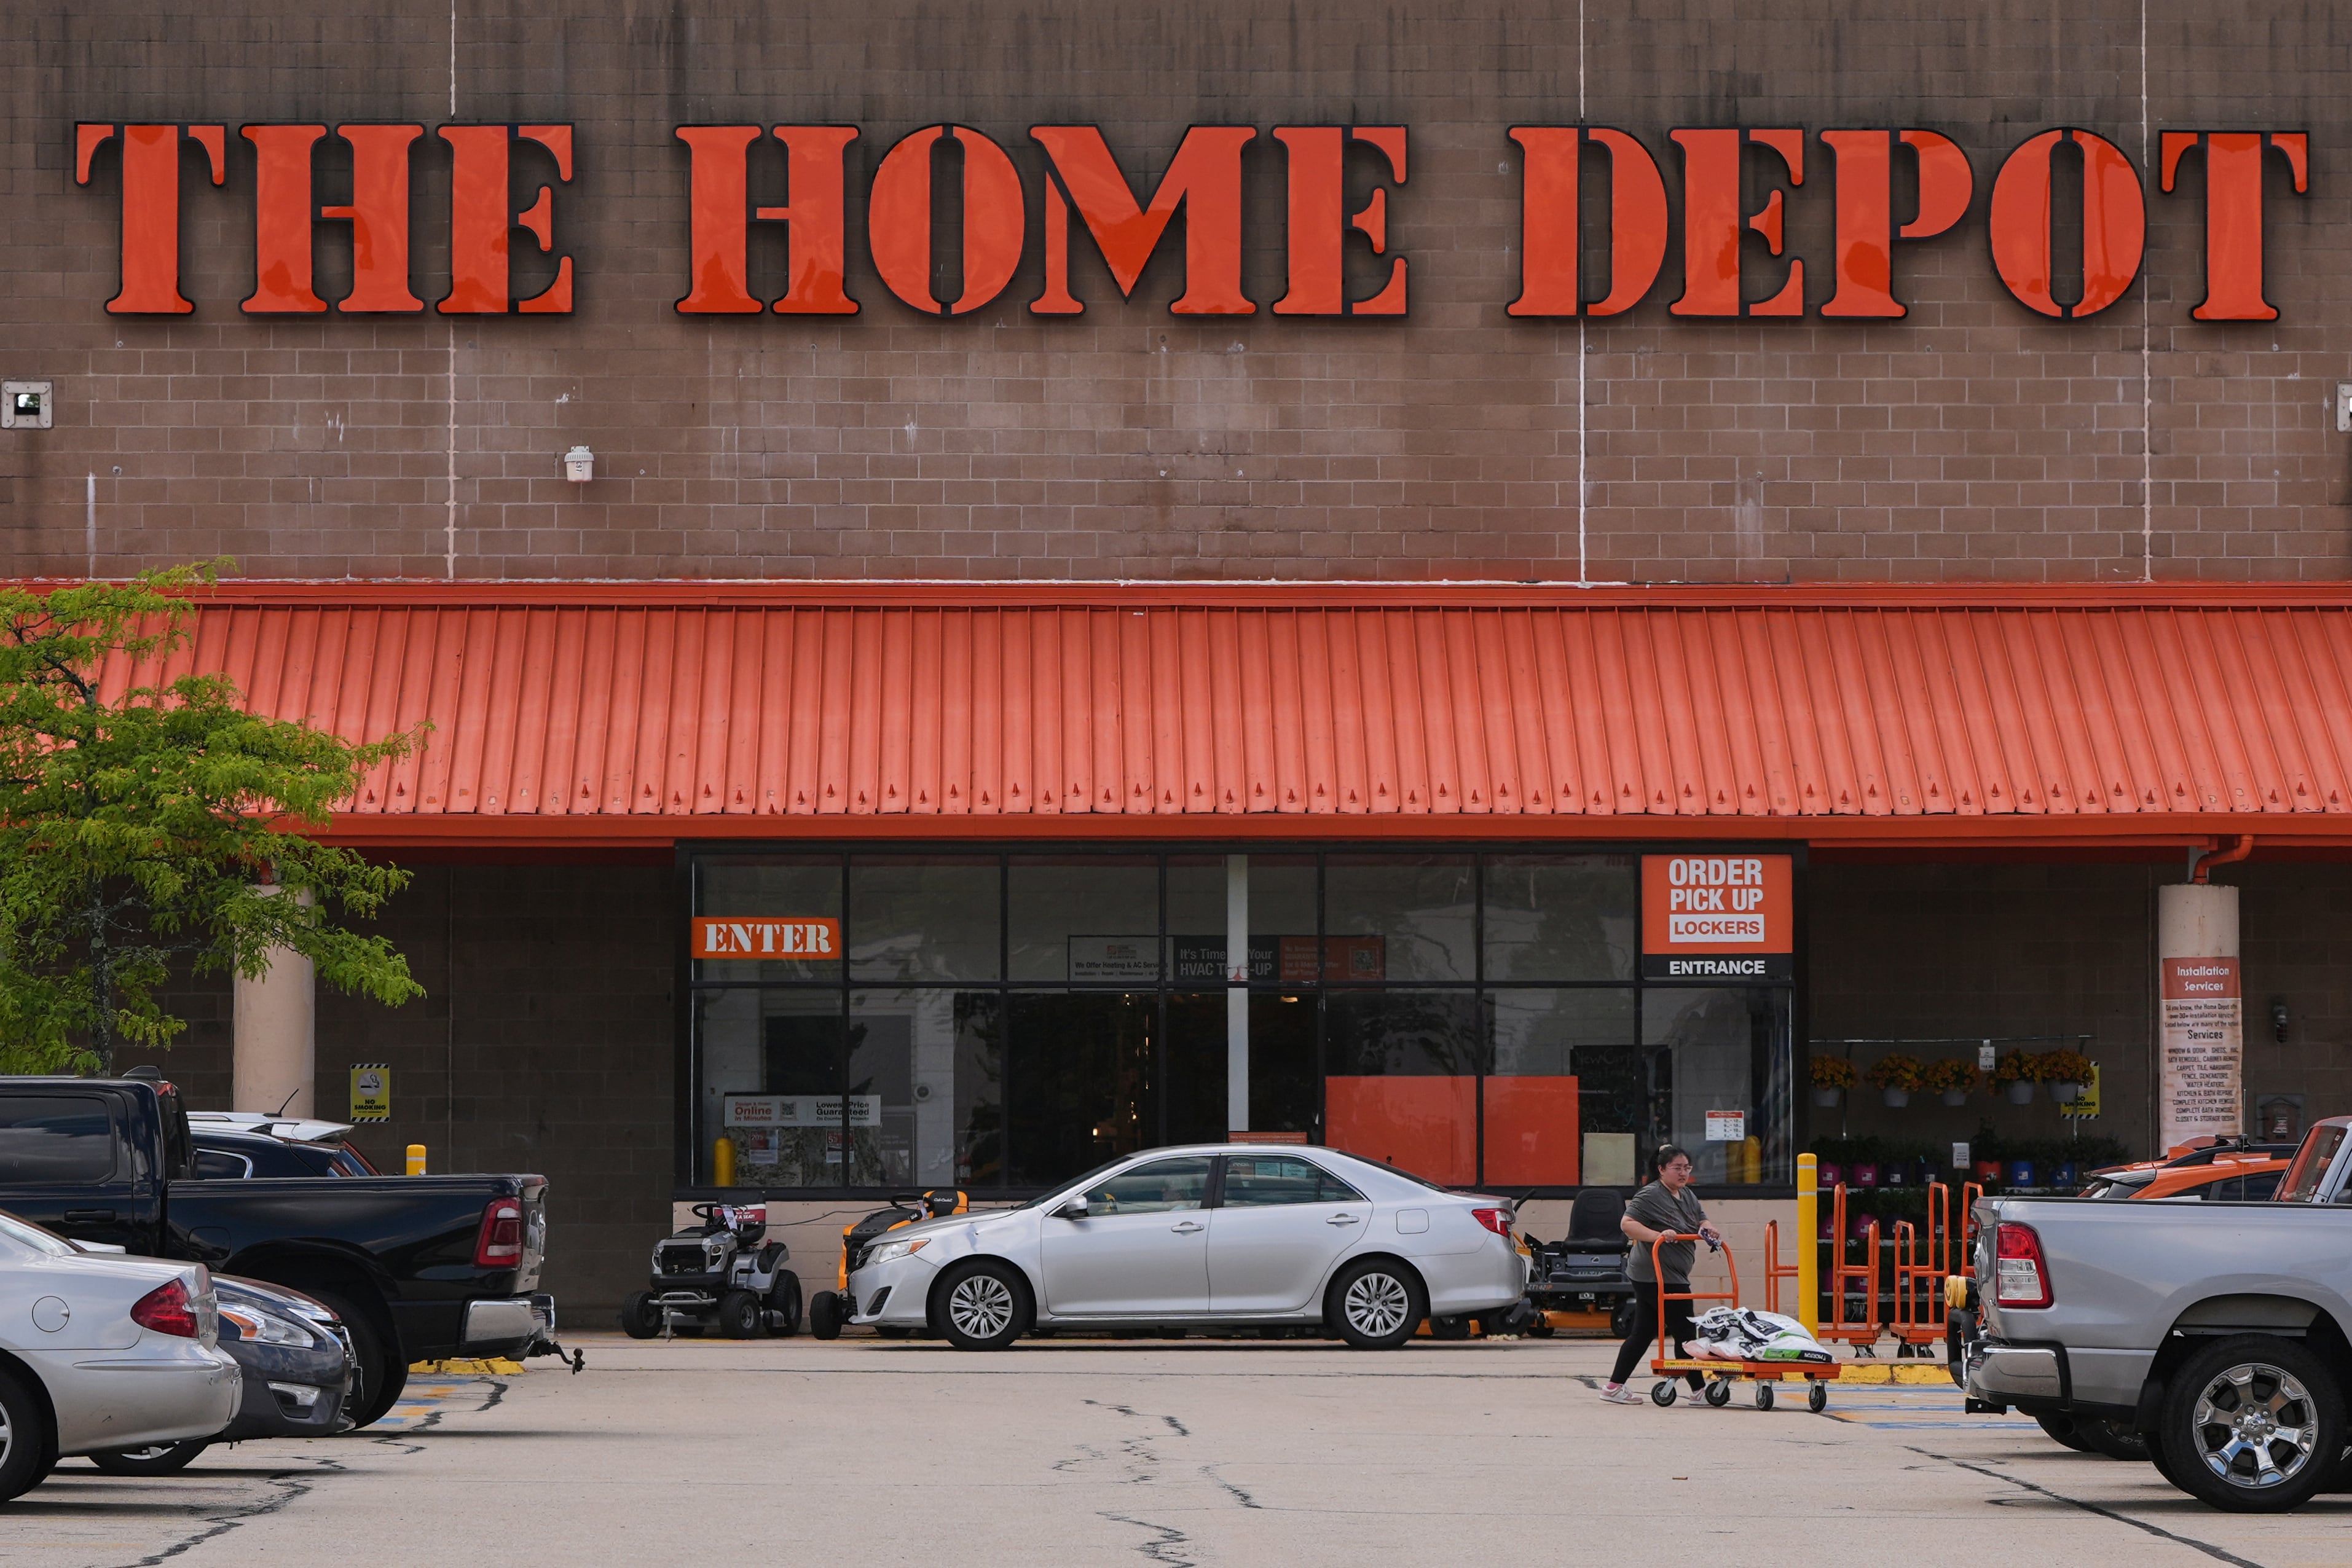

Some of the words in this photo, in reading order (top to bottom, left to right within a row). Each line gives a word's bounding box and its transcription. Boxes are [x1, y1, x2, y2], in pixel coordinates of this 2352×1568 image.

[74, 121, 575, 315] THE
[674, 123, 1409, 318] HOME
[1504, 125, 2310, 322] DEPOT
[1669, 859, 1763, 886] ORDER
[1670, 888, 1725, 911] PICK
[1732, 888, 1764, 911] UP
[1674, 921, 1760, 935] LOCKERS
[705, 923, 832, 954] ENTER
[1180, 949, 1197, 959] It's
[1200, 949, 1226, 959] Time
[1248, 949, 1273, 959] Your
[1180, 963, 1214, 976] HVAC
[1669, 960, 1766, 974] ENTRANCE
[2177, 965, 2230, 976] Installation
[2184, 981, 2224, 991] Services
[2187, 1029, 2224, 1040] Services
[735, 1107, 772, 1115] Online
